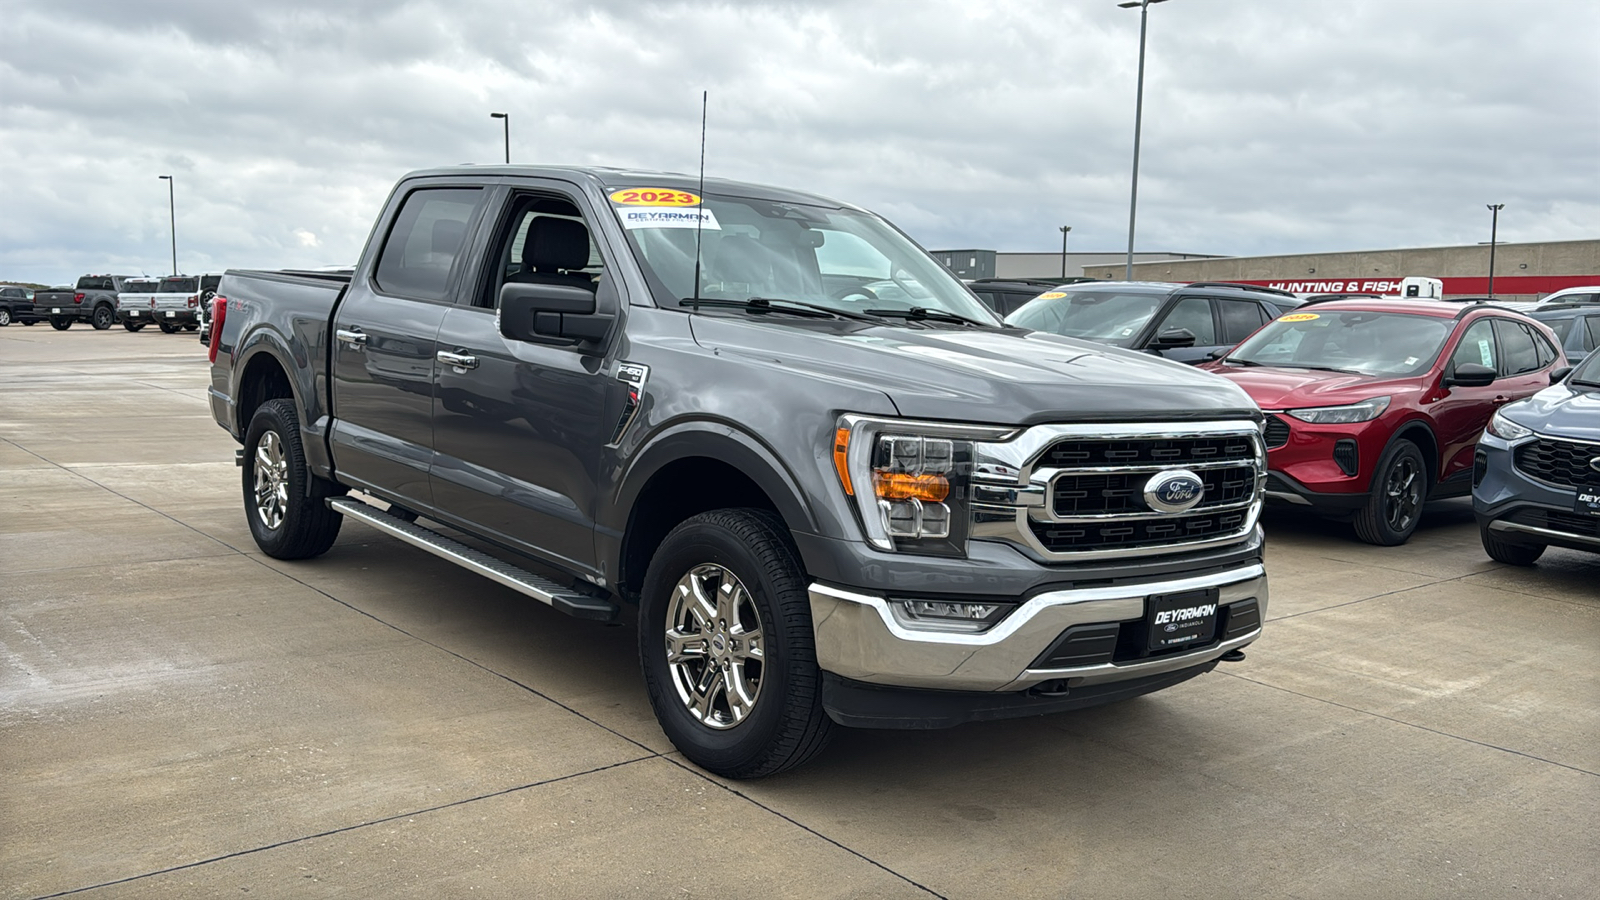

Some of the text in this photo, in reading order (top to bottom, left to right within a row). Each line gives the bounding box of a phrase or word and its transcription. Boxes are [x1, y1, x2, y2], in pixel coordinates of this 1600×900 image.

[622, 192, 694, 204] 2023
[628, 212, 709, 221] DEYARMAN
[1268, 281, 1402, 292] HUNTING & FISH
[1166, 481, 1194, 501] Ford
[1578, 493, 1600, 503] DEY
[1154, 604, 1216, 625] DEYARMAN
[1179, 620, 1204, 628] INDIANOLA
